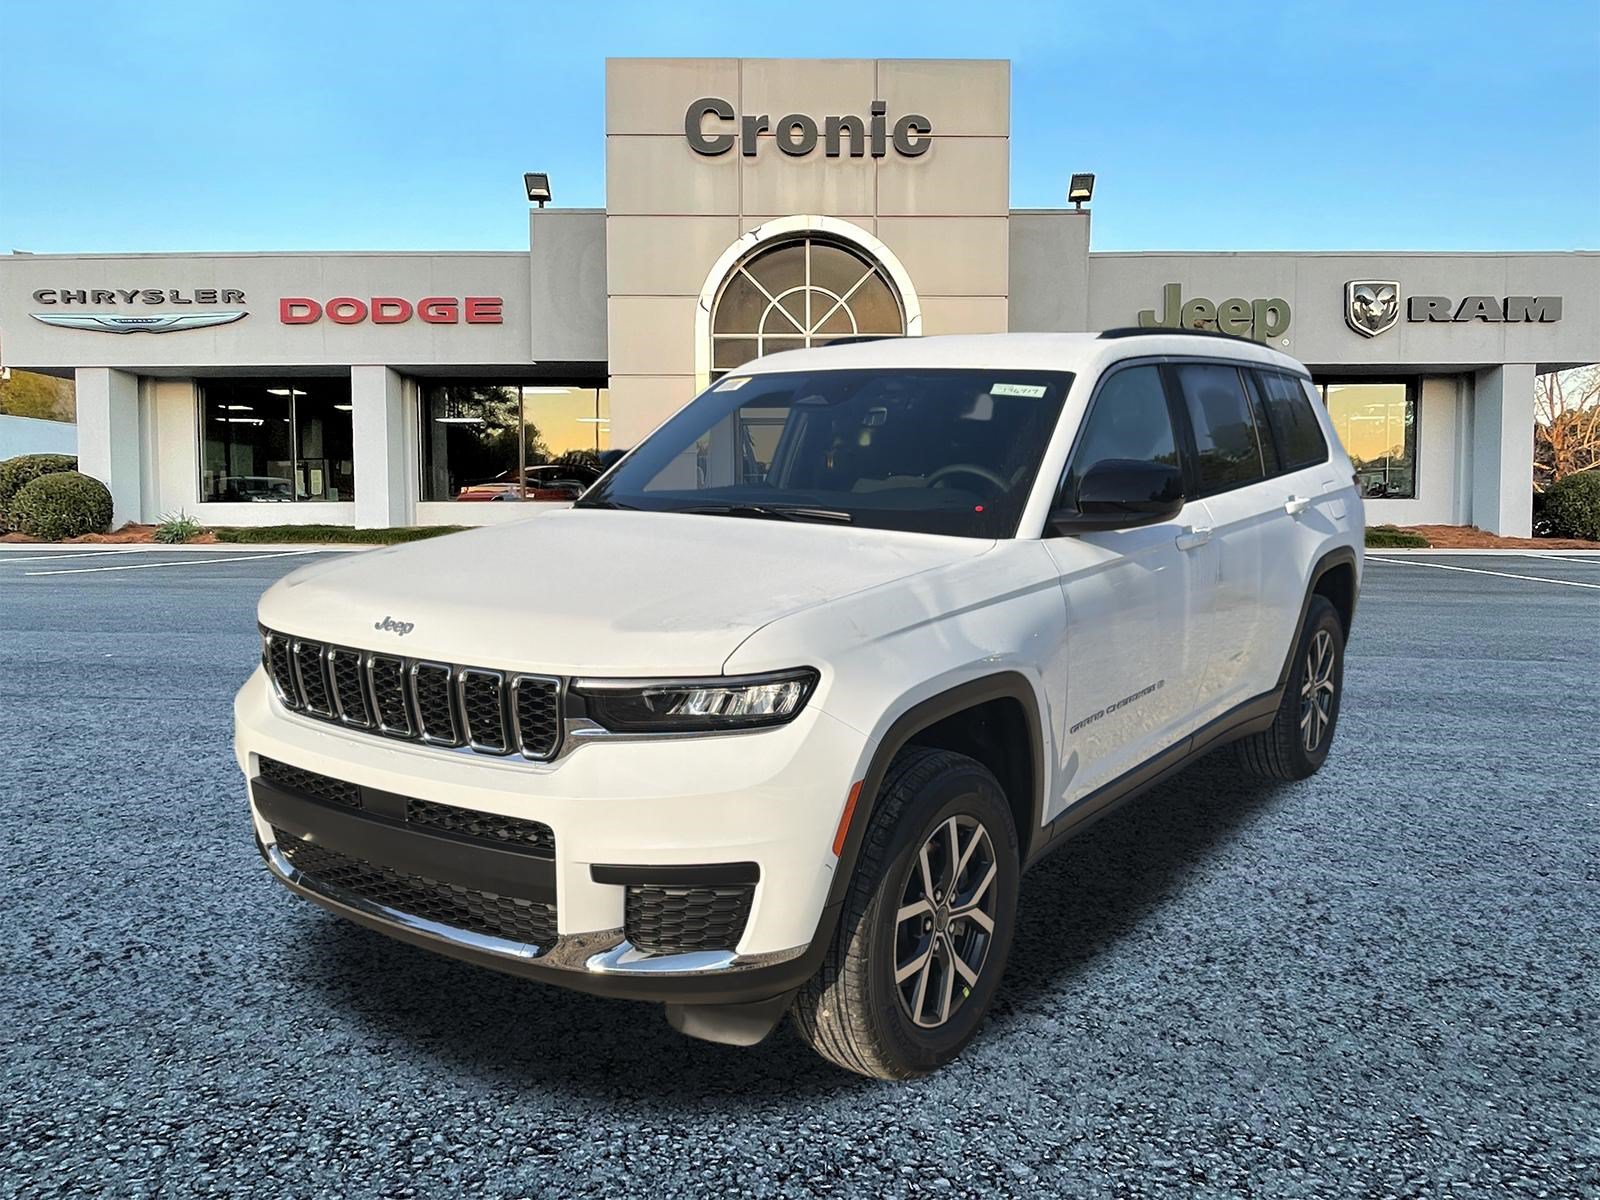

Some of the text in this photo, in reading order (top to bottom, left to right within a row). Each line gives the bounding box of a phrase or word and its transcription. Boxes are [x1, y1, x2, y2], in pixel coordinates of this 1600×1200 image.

[685, 97, 932, 158] Cronic
[32, 289, 248, 304] CHRYSLER
[1407, 295, 1563, 323] RAM
[279, 297, 504, 325] DODGE
[1138, 283, 1291, 344] Jeep
[374, 616, 415, 637] Jeep
